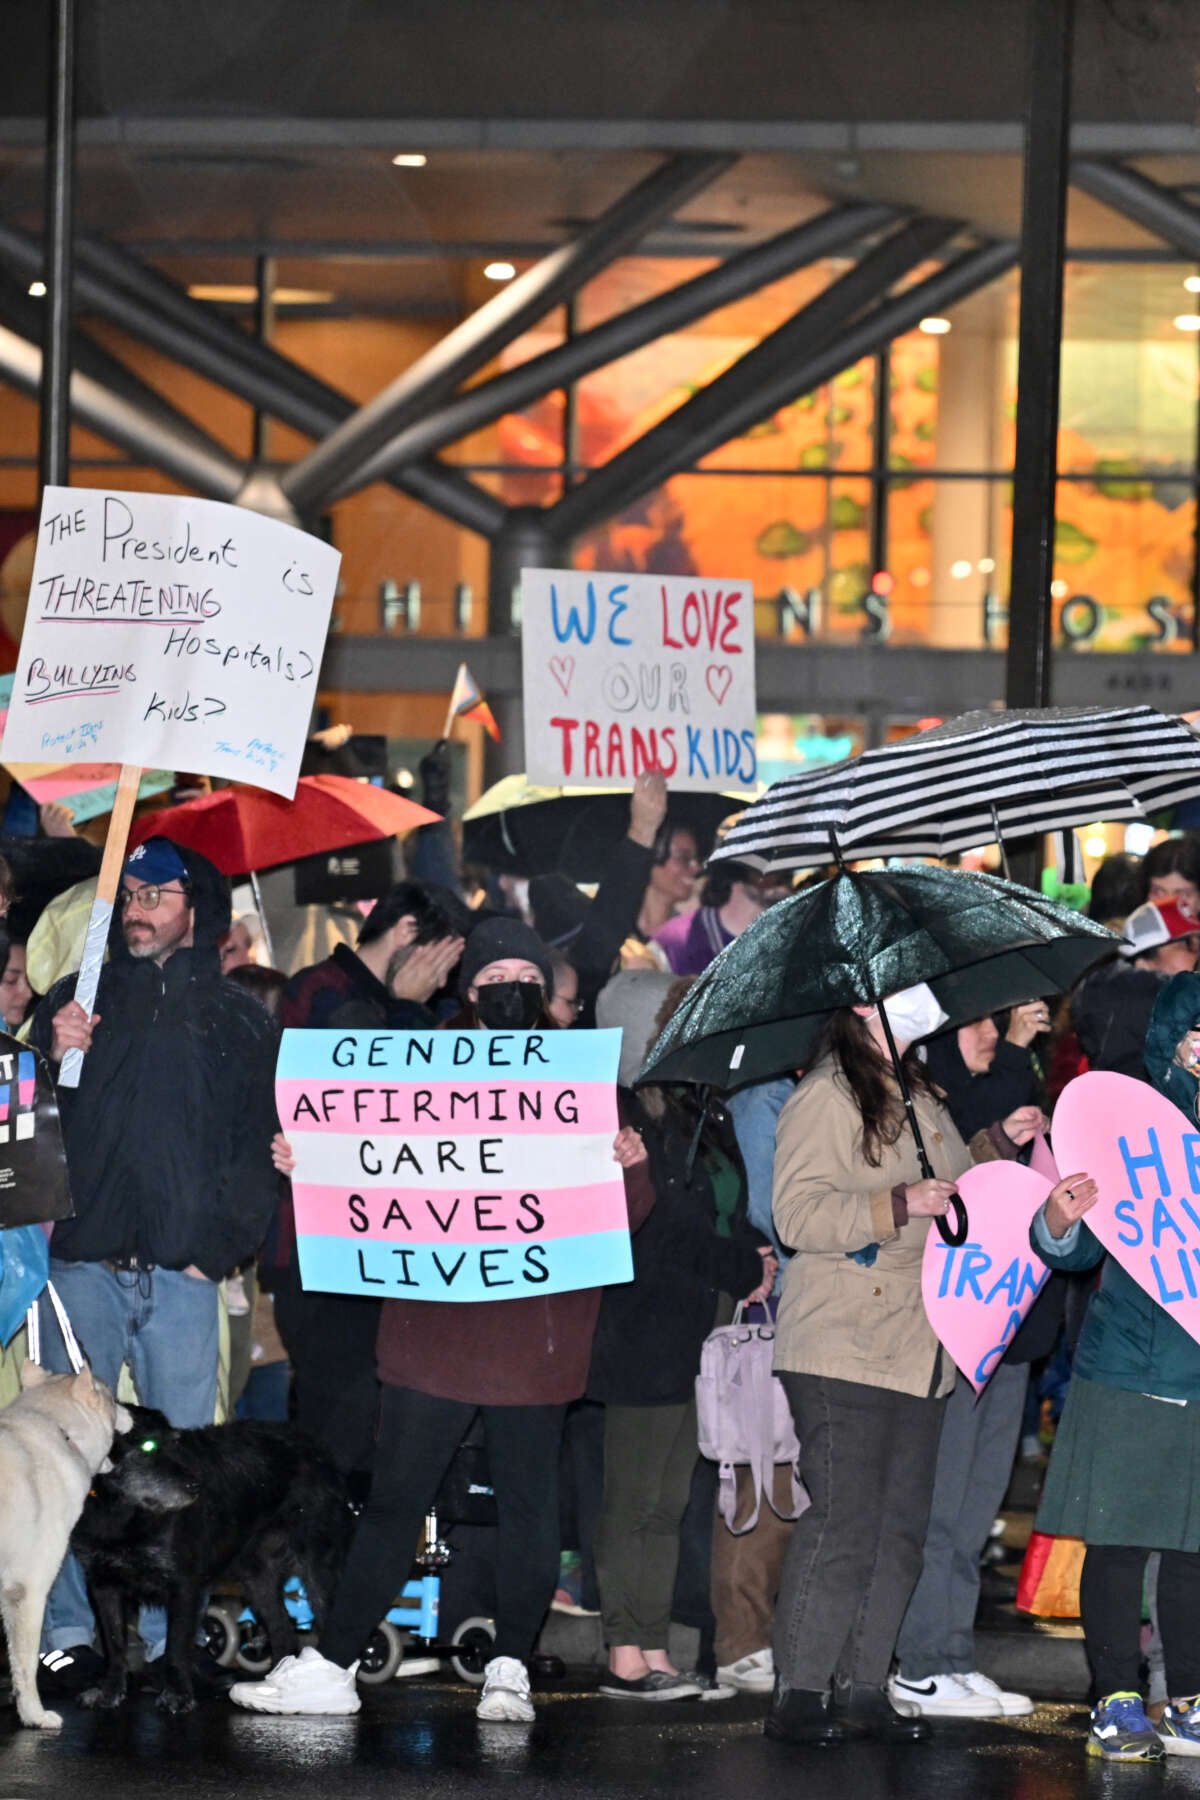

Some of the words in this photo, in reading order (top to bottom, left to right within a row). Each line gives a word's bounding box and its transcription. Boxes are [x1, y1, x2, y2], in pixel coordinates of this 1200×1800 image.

[45, 509, 86, 545] THE
[103, 497, 238, 568] President
[281, 561, 314, 595] is
[38, 574, 222, 618] THREATENING
[549, 580, 633, 646] WE
[661, 584, 743, 654] LOVE
[26, 657, 138, 696] BULLYING
[164, 627, 314, 688] Hospitals?
[604, 661, 692, 714] OUR
[549, 716, 678, 779] TRANS
[687, 723, 758, 784] KIDS
[332, 1035, 551, 1067] GENDER
[293, 1089, 580, 1124] AFFIRMING
[359, 1138, 504, 1176] CARE
[348, 1193, 546, 1234] SAVES
[358, 1245, 550, 1288] LIVES
[935, 1242, 1052, 1307] TRAN
